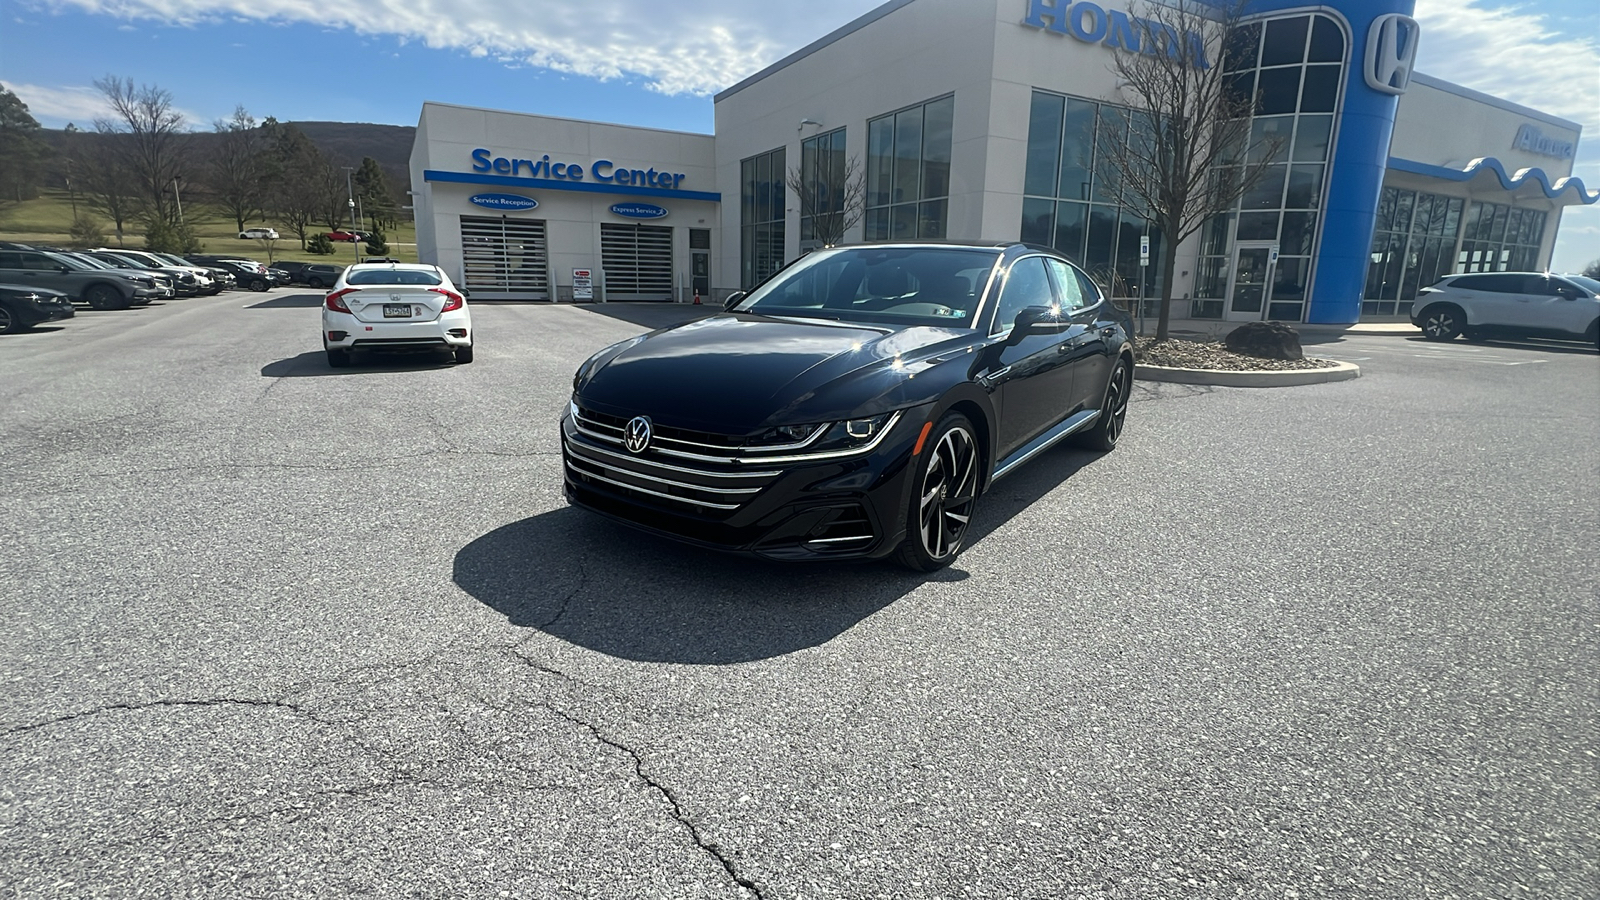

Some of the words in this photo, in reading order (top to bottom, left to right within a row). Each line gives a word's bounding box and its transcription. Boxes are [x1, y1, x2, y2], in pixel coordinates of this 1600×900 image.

[1024, 0, 1210, 69] HONDA
[472, 148, 583, 180] Service
[592, 160, 685, 188] Center
[501, 198, 534, 206] Reception
